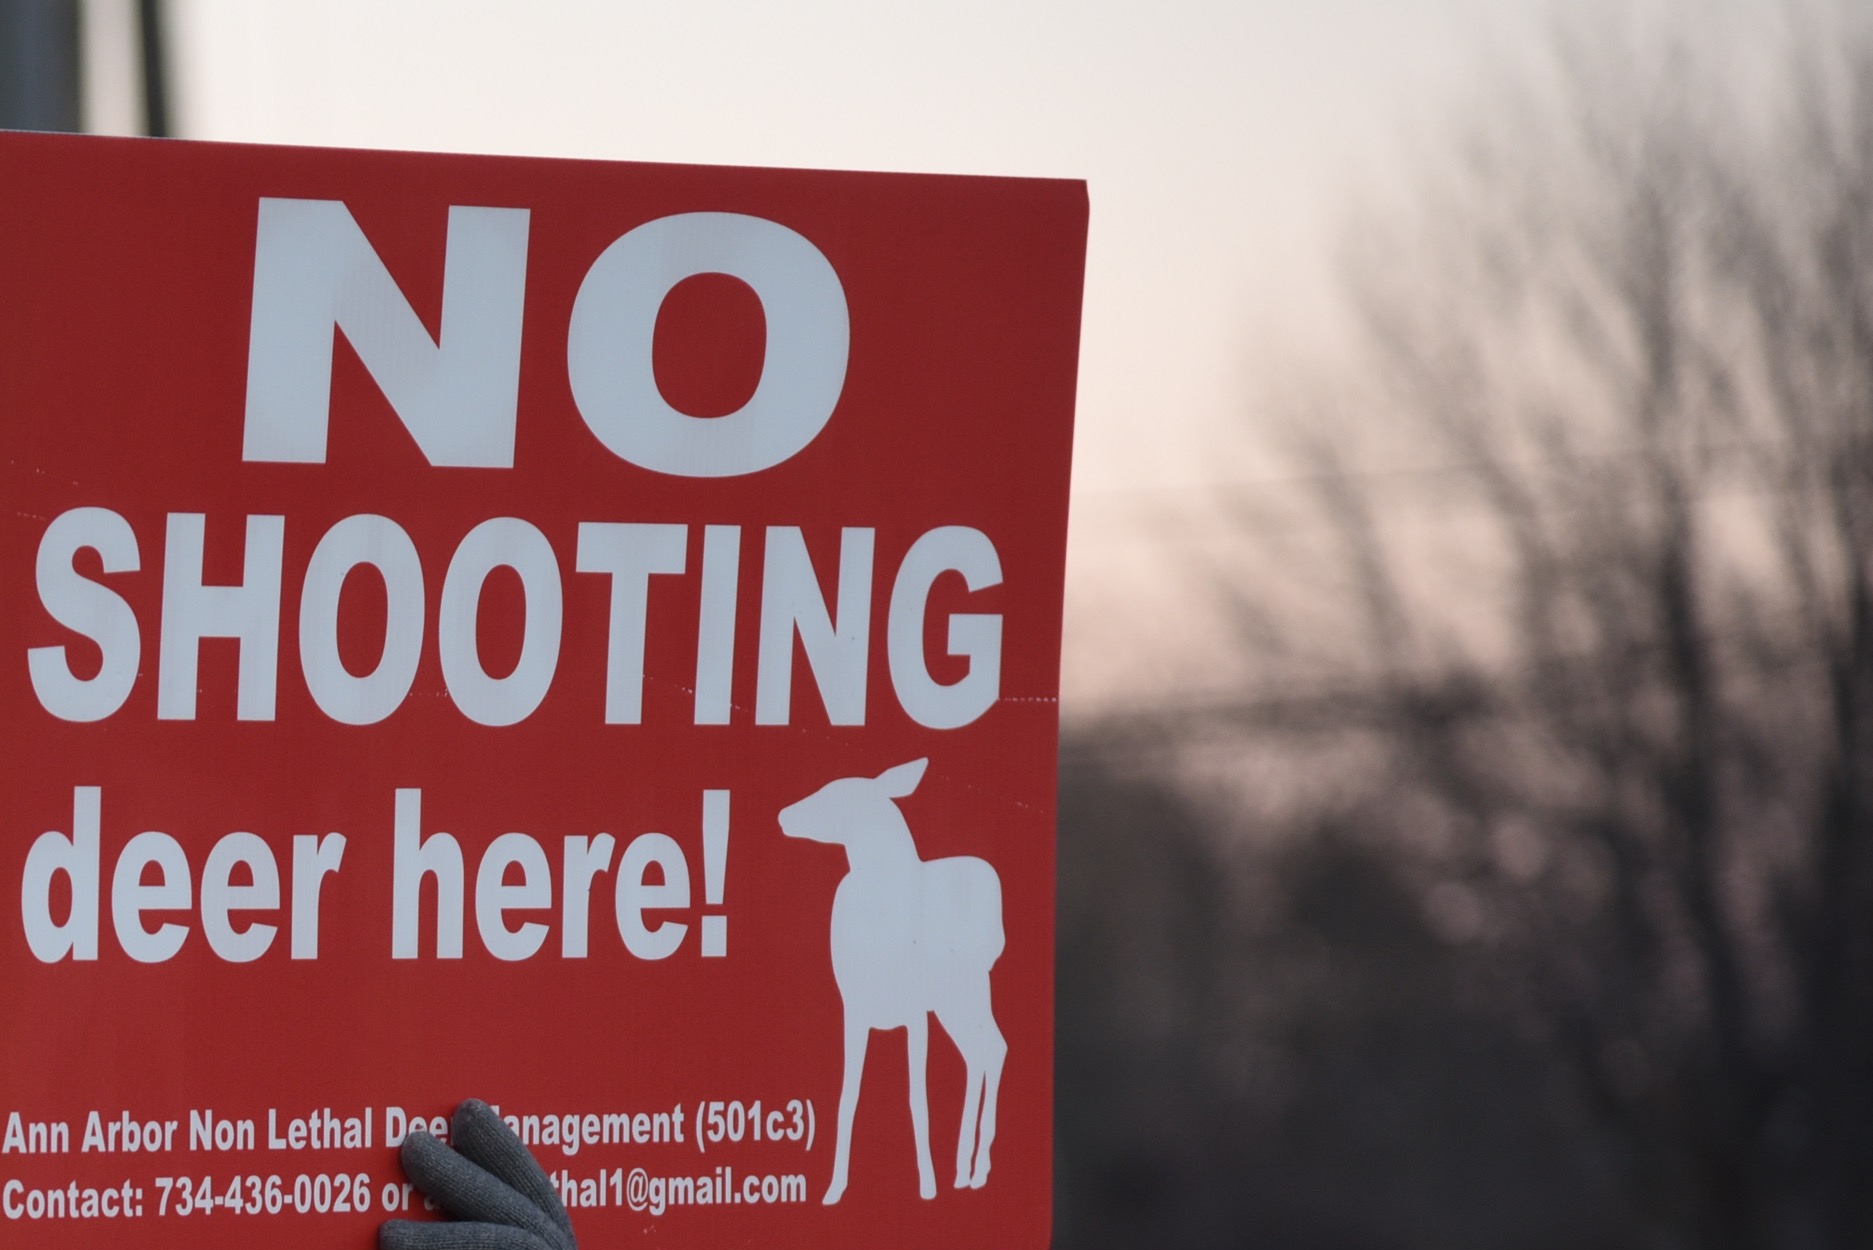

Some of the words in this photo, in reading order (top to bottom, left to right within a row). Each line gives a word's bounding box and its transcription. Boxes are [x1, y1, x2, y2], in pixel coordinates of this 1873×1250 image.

[240, 195, 852, 479] NO
[26, 505, 1005, 731] SHOOTING
[20, 785, 348, 966] deer
[390, 787, 732, 964] here!
[1, 1110, 70, 1154] Ann
[81, 1109, 180, 1154] Arbor
[189, 1108, 255, 1152] Non
[268, 1106, 373, 1151] Lethal
[384, 1105, 454, 1149] Dee
[488, 1102, 685, 1156] anagement
[694, 1099, 817, 1154] (501c3)
[1, 1178, 144, 1221] Contact:
[154, 1172, 372, 1218] 734-436-0026
[381, 1181, 415, 1213] or
